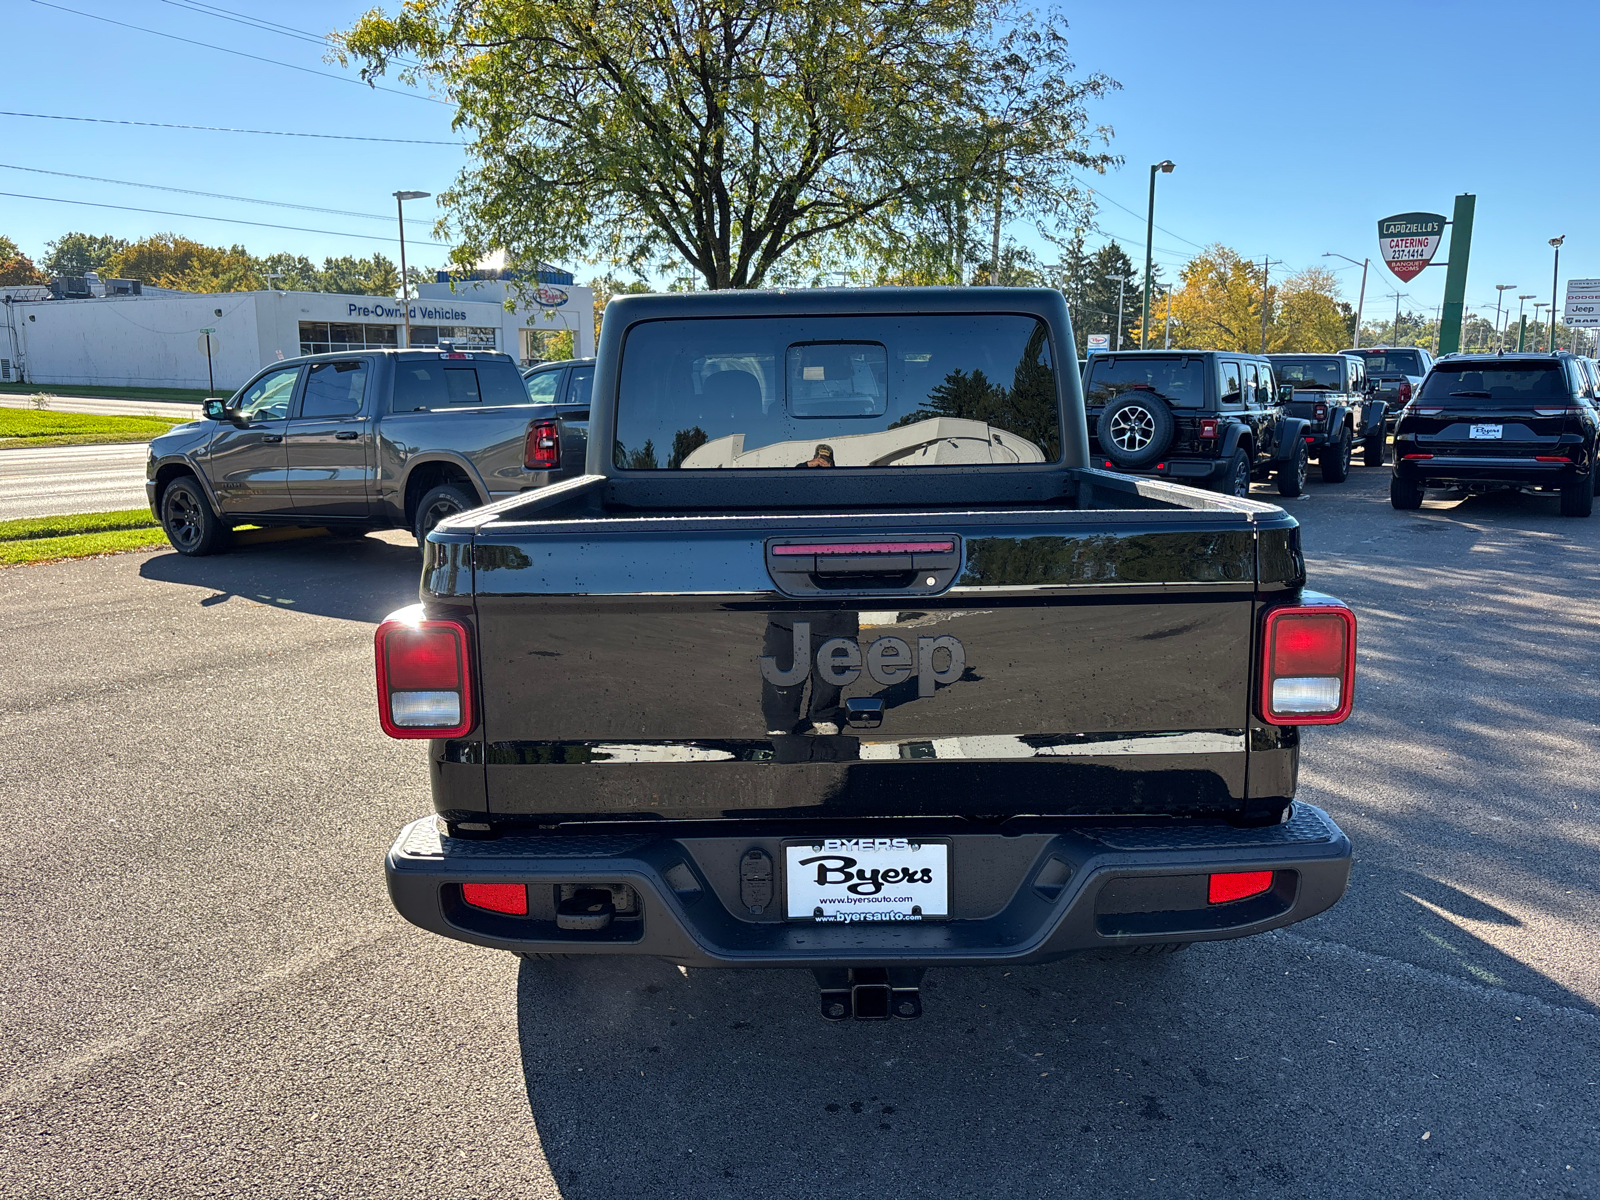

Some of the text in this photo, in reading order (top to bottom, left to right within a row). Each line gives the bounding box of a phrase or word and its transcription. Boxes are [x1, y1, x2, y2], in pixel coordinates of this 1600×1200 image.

[1383, 221, 1439, 235] CAPOZIELLO'S
[1389, 236, 1429, 249] CATERING
[1391, 248, 1424, 260] 237-1414
[1391, 260, 1423, 268] BANQUET
[534, 288, 567, 304] Byer
[348, 303, 467, 321] Pre-Ownd Vehicles
[1571, 305, 1595, 313] Jeep
[759, 620, 966, 698] Jeep
[824, 838, 909, 852] BYERS
[798, 855, 933, 896] Byers
[819, 895, 913, 905] www.byersauto.com
[815, 910, 922, 924] www.byersauto.com
